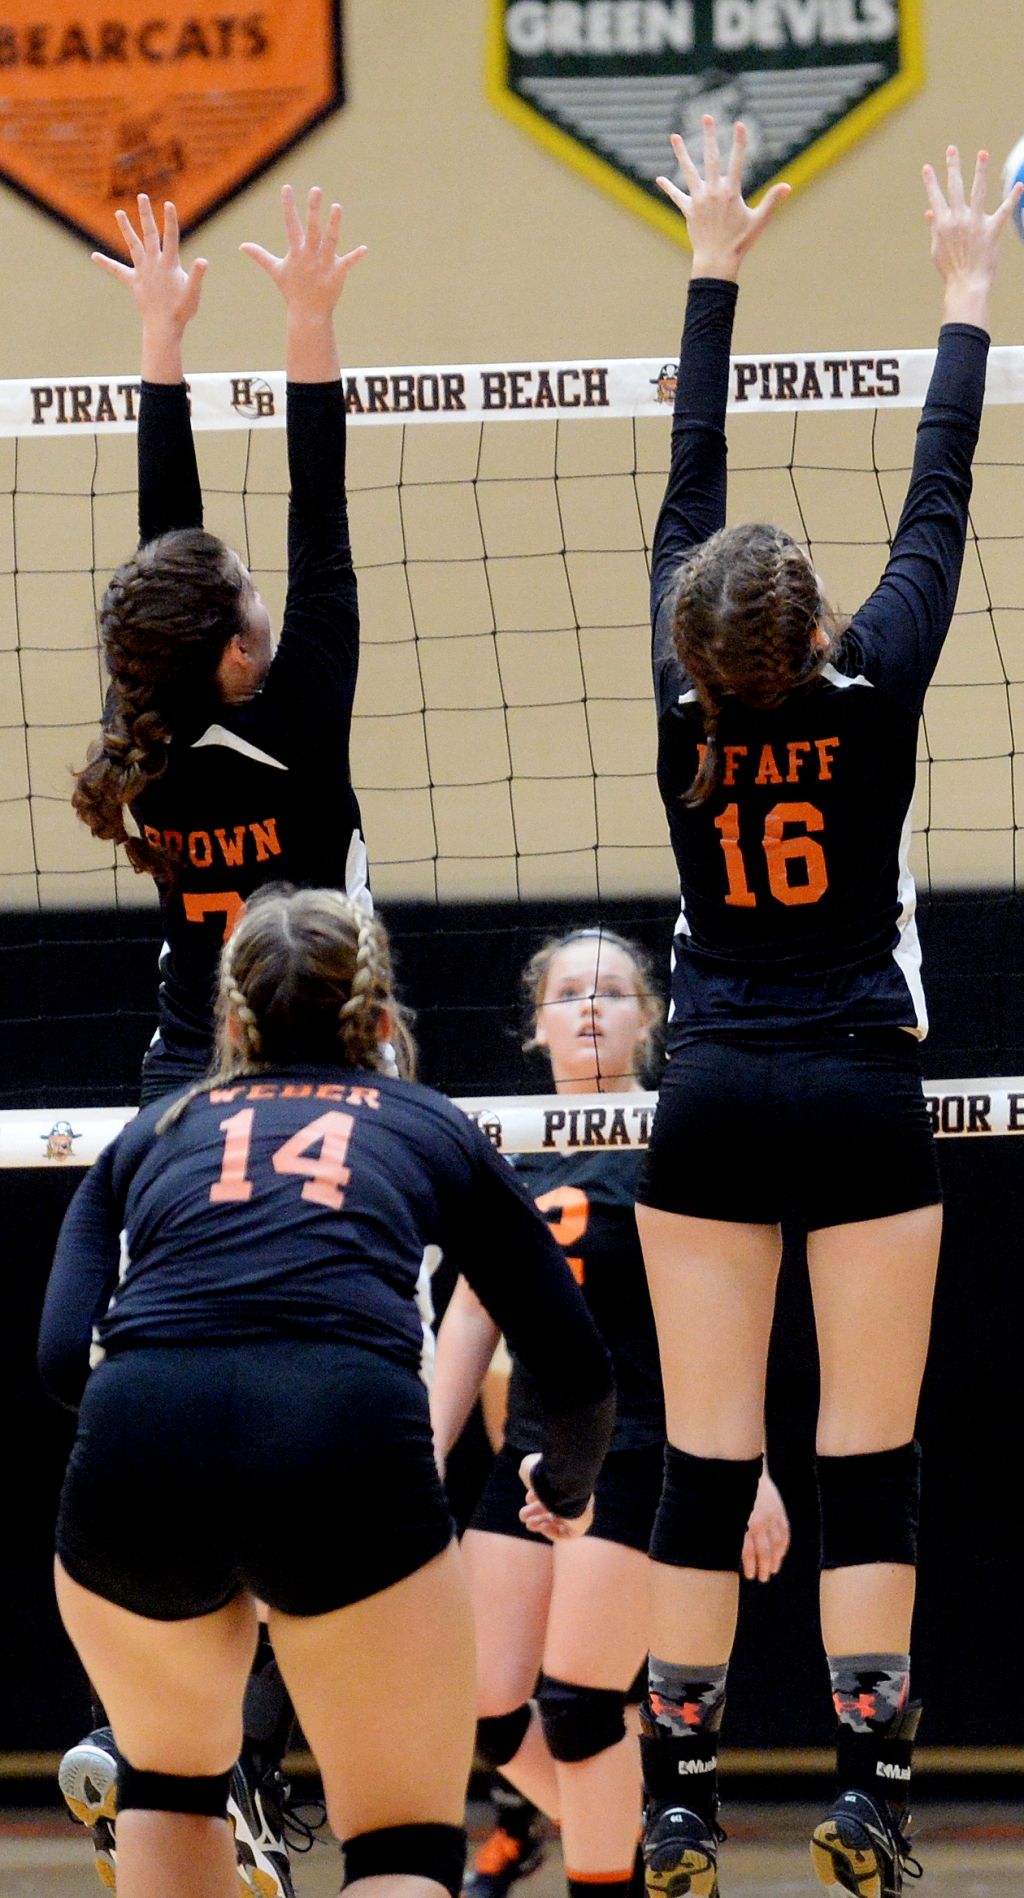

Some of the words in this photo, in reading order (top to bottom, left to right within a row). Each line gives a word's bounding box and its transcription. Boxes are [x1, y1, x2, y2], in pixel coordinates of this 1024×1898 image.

[0, 14, 268, 68] BEARCATS
[506, 0, 692, 55] GREEN
[712, 0, 898, 50] DEVILS
[31, 383, 192, 425] PIRAT
[344, 371, 466, 414] ARBOR
[480, 367, 610, 410] BEACH
[734, 357, 901, 401] PIRATES
[714, 801, 829, 908] 16
[543, 1107, 657, 1148] PIRAT
[209, 1107, 355, 1211] 14
